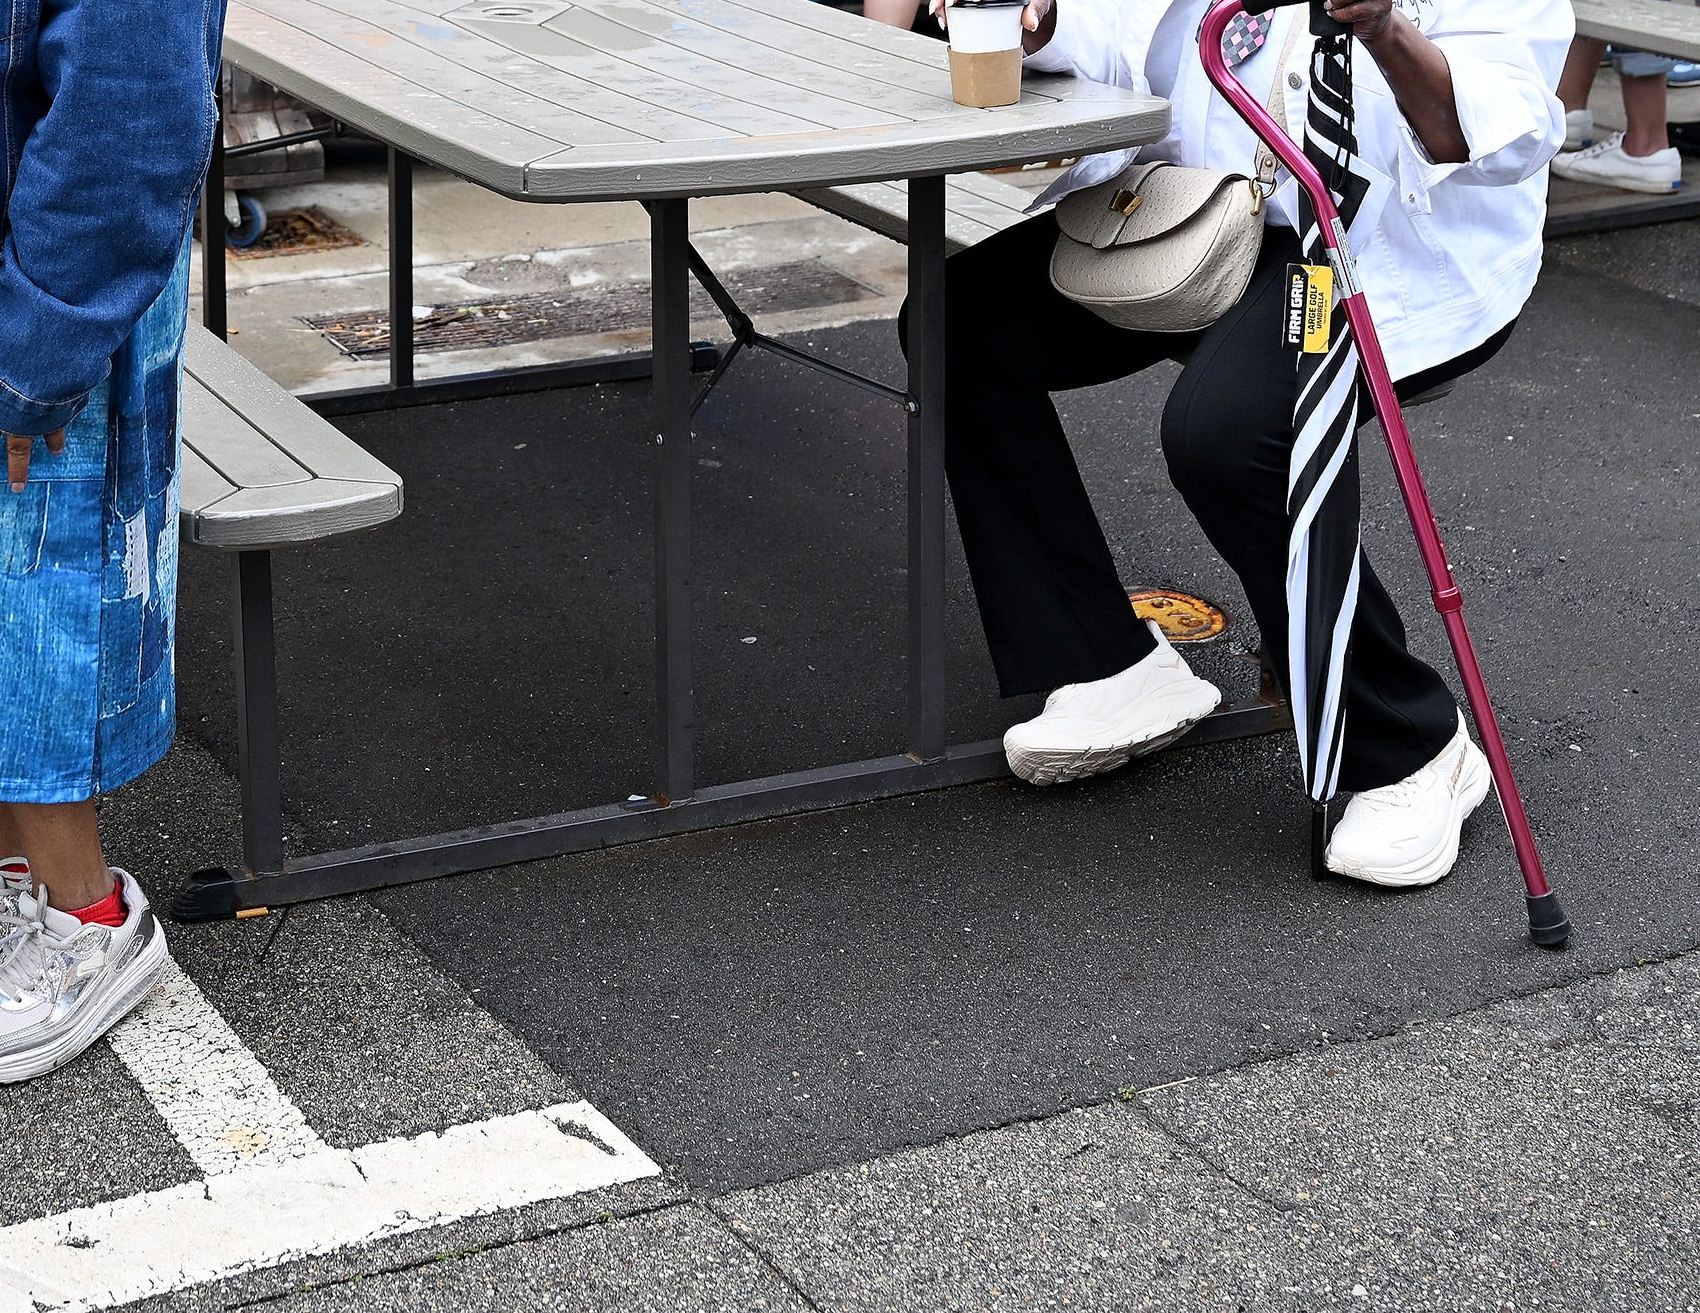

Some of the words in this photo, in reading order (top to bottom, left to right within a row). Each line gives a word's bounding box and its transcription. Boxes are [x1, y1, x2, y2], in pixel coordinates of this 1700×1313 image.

[1290, 274, 1305, 308] GRIP
[1310, 284, 1318, 306] GOLF
[1288, 310, 1302, 344] FIRM
[1308, 307, 1317, 335] LARGE
[1315, 292, 1325, 329] UMBRELLA
